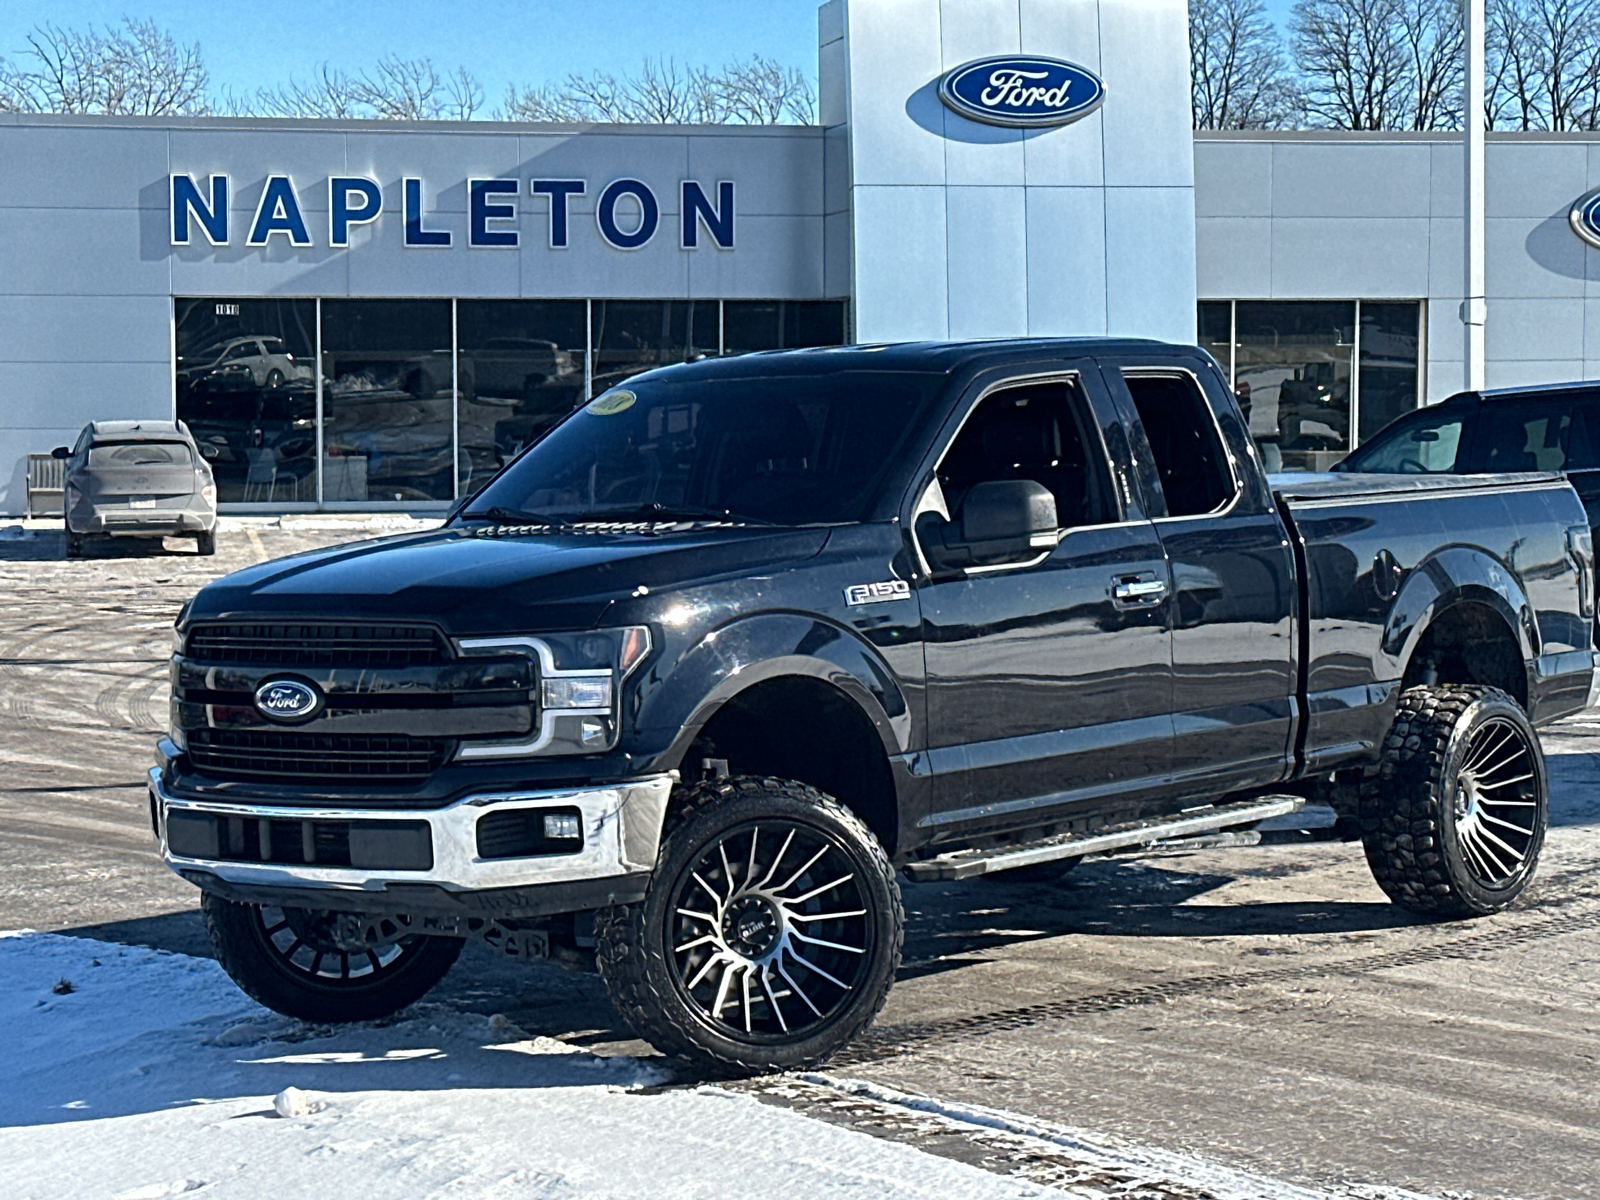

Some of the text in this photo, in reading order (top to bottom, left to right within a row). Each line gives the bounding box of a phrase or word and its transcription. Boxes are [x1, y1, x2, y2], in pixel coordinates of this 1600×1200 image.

[981, 69, 1071, 107] Ford
[170, 173, 735, 250] NAPLETON
[268, 689, 300, 708] Ford
